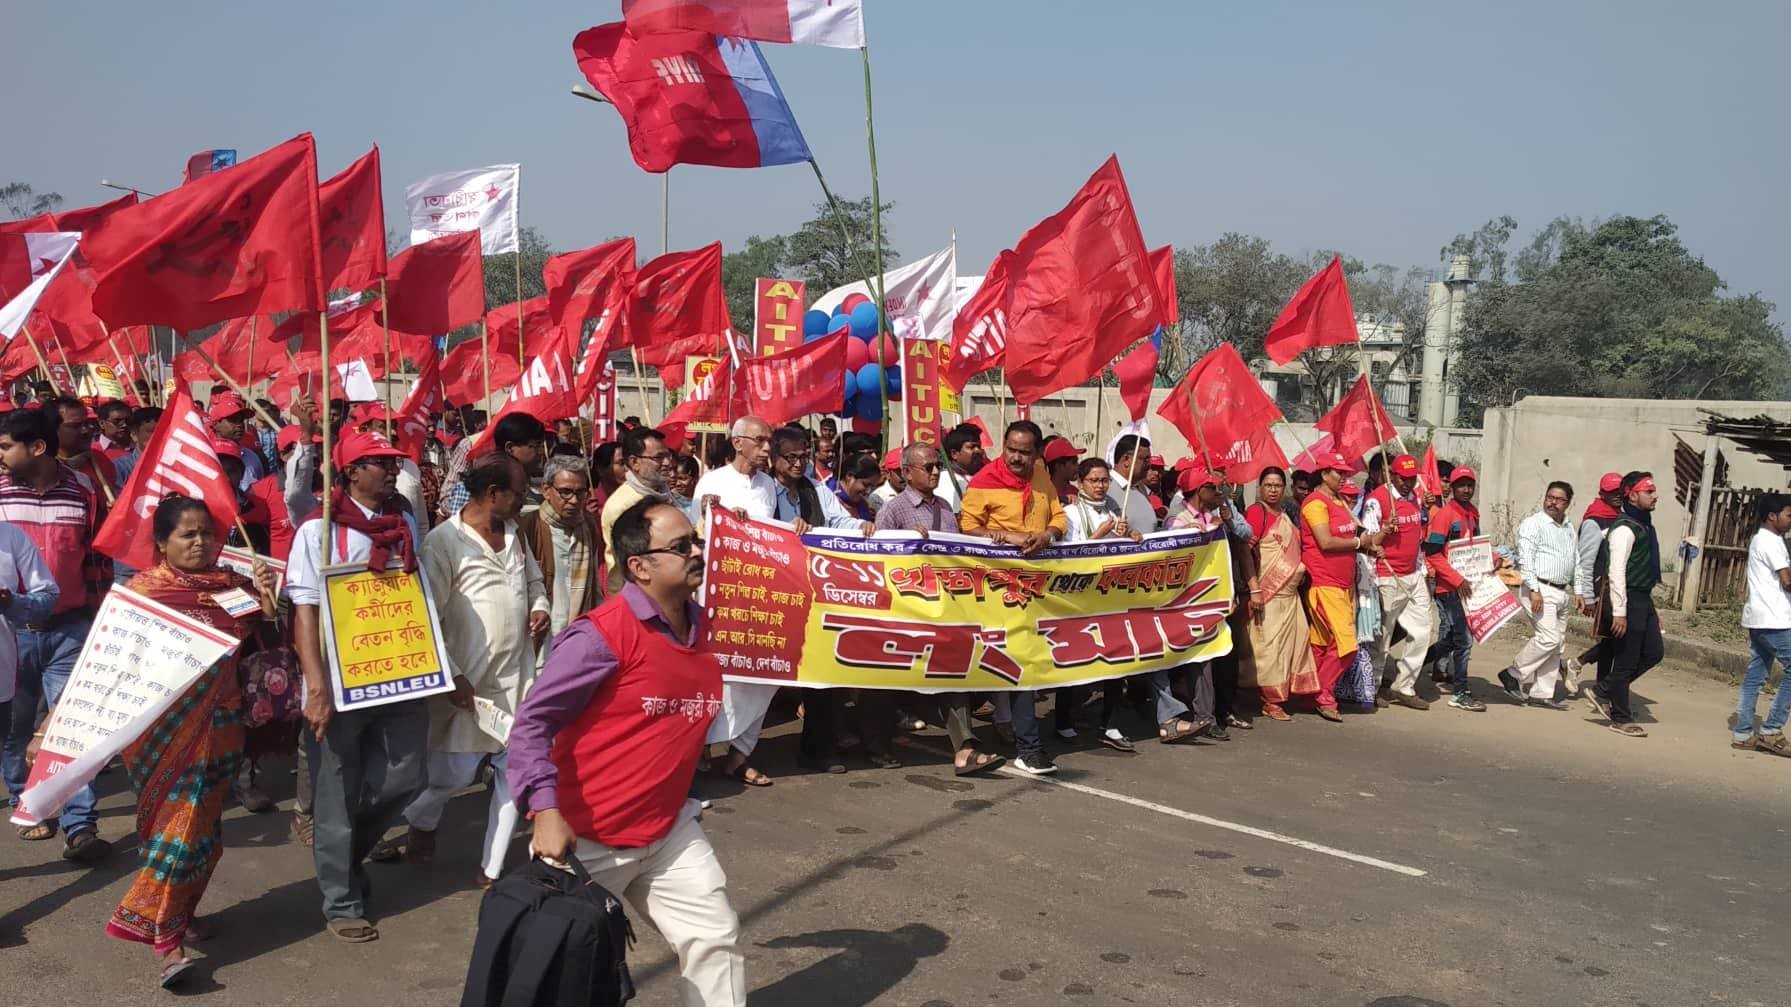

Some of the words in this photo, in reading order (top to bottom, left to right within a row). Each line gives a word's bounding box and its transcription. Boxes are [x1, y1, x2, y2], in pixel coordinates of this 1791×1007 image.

[908, 340, 936, 446] AITUC
[821, 582, 878, 607] ডিসেম্বর
[352, 599, 414, 621] কর্মীদের
[351, 631, 394, 651] বেতন
[396, 620, 426, 647] বৃদ্ধি
[823, 612, 1024, 684] লং
[1037, 578, 1232, 665] মার্চ
[343, 657, 395, 678] করতে
[349, 674, 440, 701] BSNLEU
[641, 696, 668, 716] কাজ
